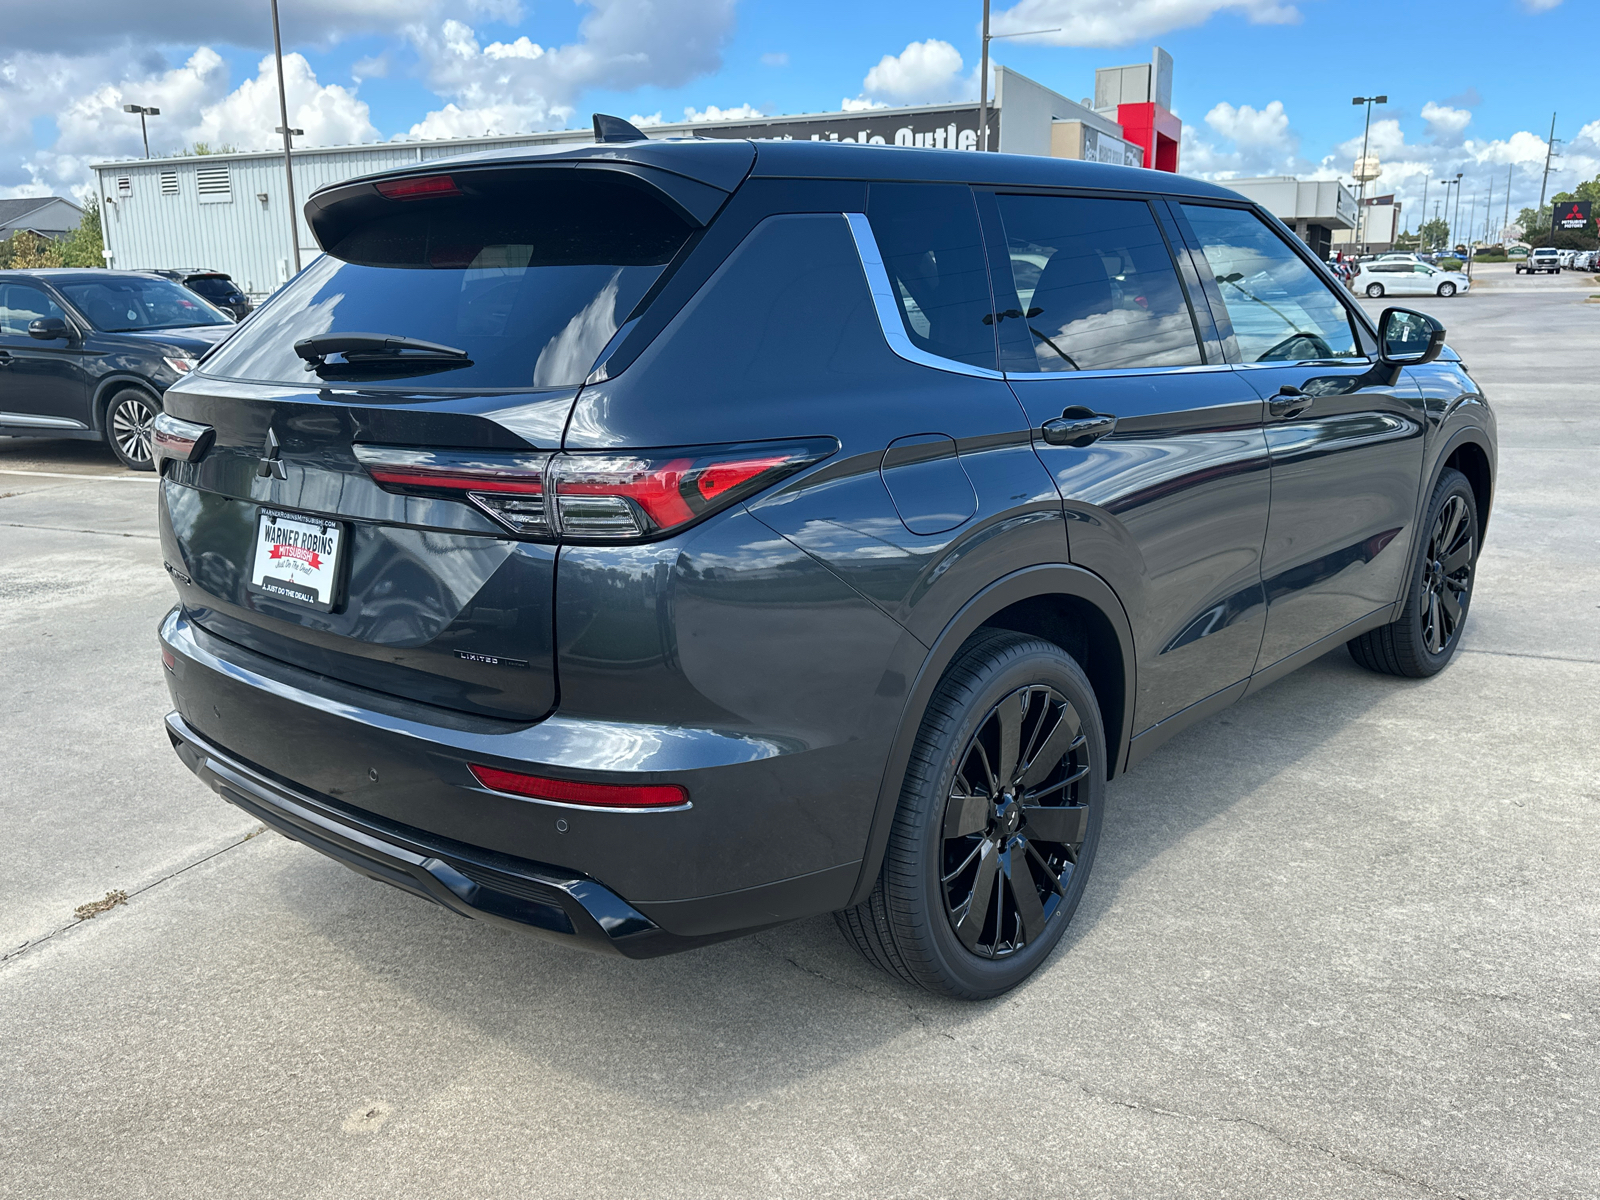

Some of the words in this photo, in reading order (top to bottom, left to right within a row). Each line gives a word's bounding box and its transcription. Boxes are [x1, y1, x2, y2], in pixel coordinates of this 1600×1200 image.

[894, 123, 991, 151] Outlet
[264, 524, 300, 548] WARNER
[302, 532, 333, 556] ROBINS
[278, 545, 314, 563] MITSUBISHI
[266, 584, 278, 593] JUST
[277, 587, 286, 595] DO
[285, 588, 295, 598] THE
[460, 652, 498, 664] LIMITED
